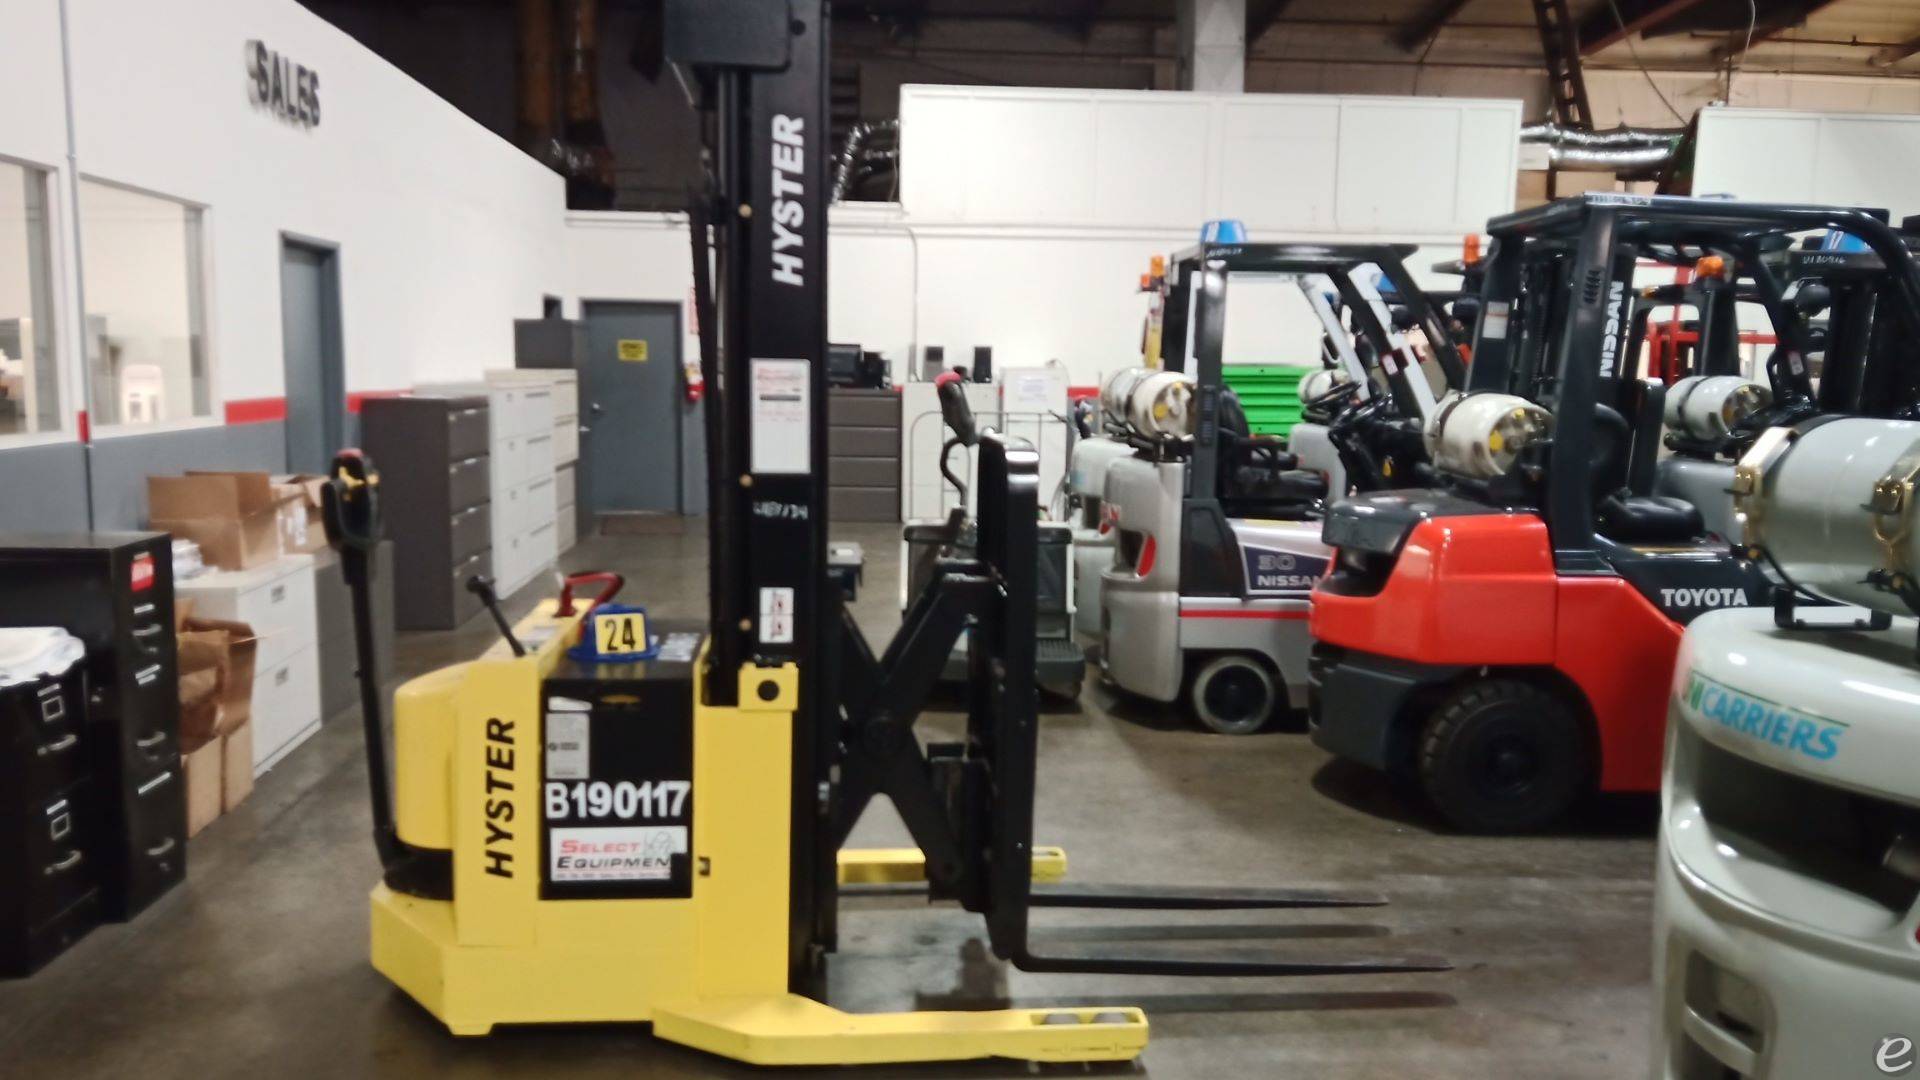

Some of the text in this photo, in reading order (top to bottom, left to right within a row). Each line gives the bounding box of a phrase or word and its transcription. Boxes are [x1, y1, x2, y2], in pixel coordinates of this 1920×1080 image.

[251, 38, 320, 128] SALES
[771, 113, 804, 287] HYSTER
[1599, 281, 1624, 377] NISSAN
[1258, 554, 1296, 571] 30
[1660, 588, 1748, 606] TOYOTA
[605, 618, 636, 651] 24
[1702, 686, 1843, 760] CARRIERS
[485, 717, 515, 879] HYSTER
[545, 780, 691, 818] B190117
[560, 839, 640, 853] SELECT
